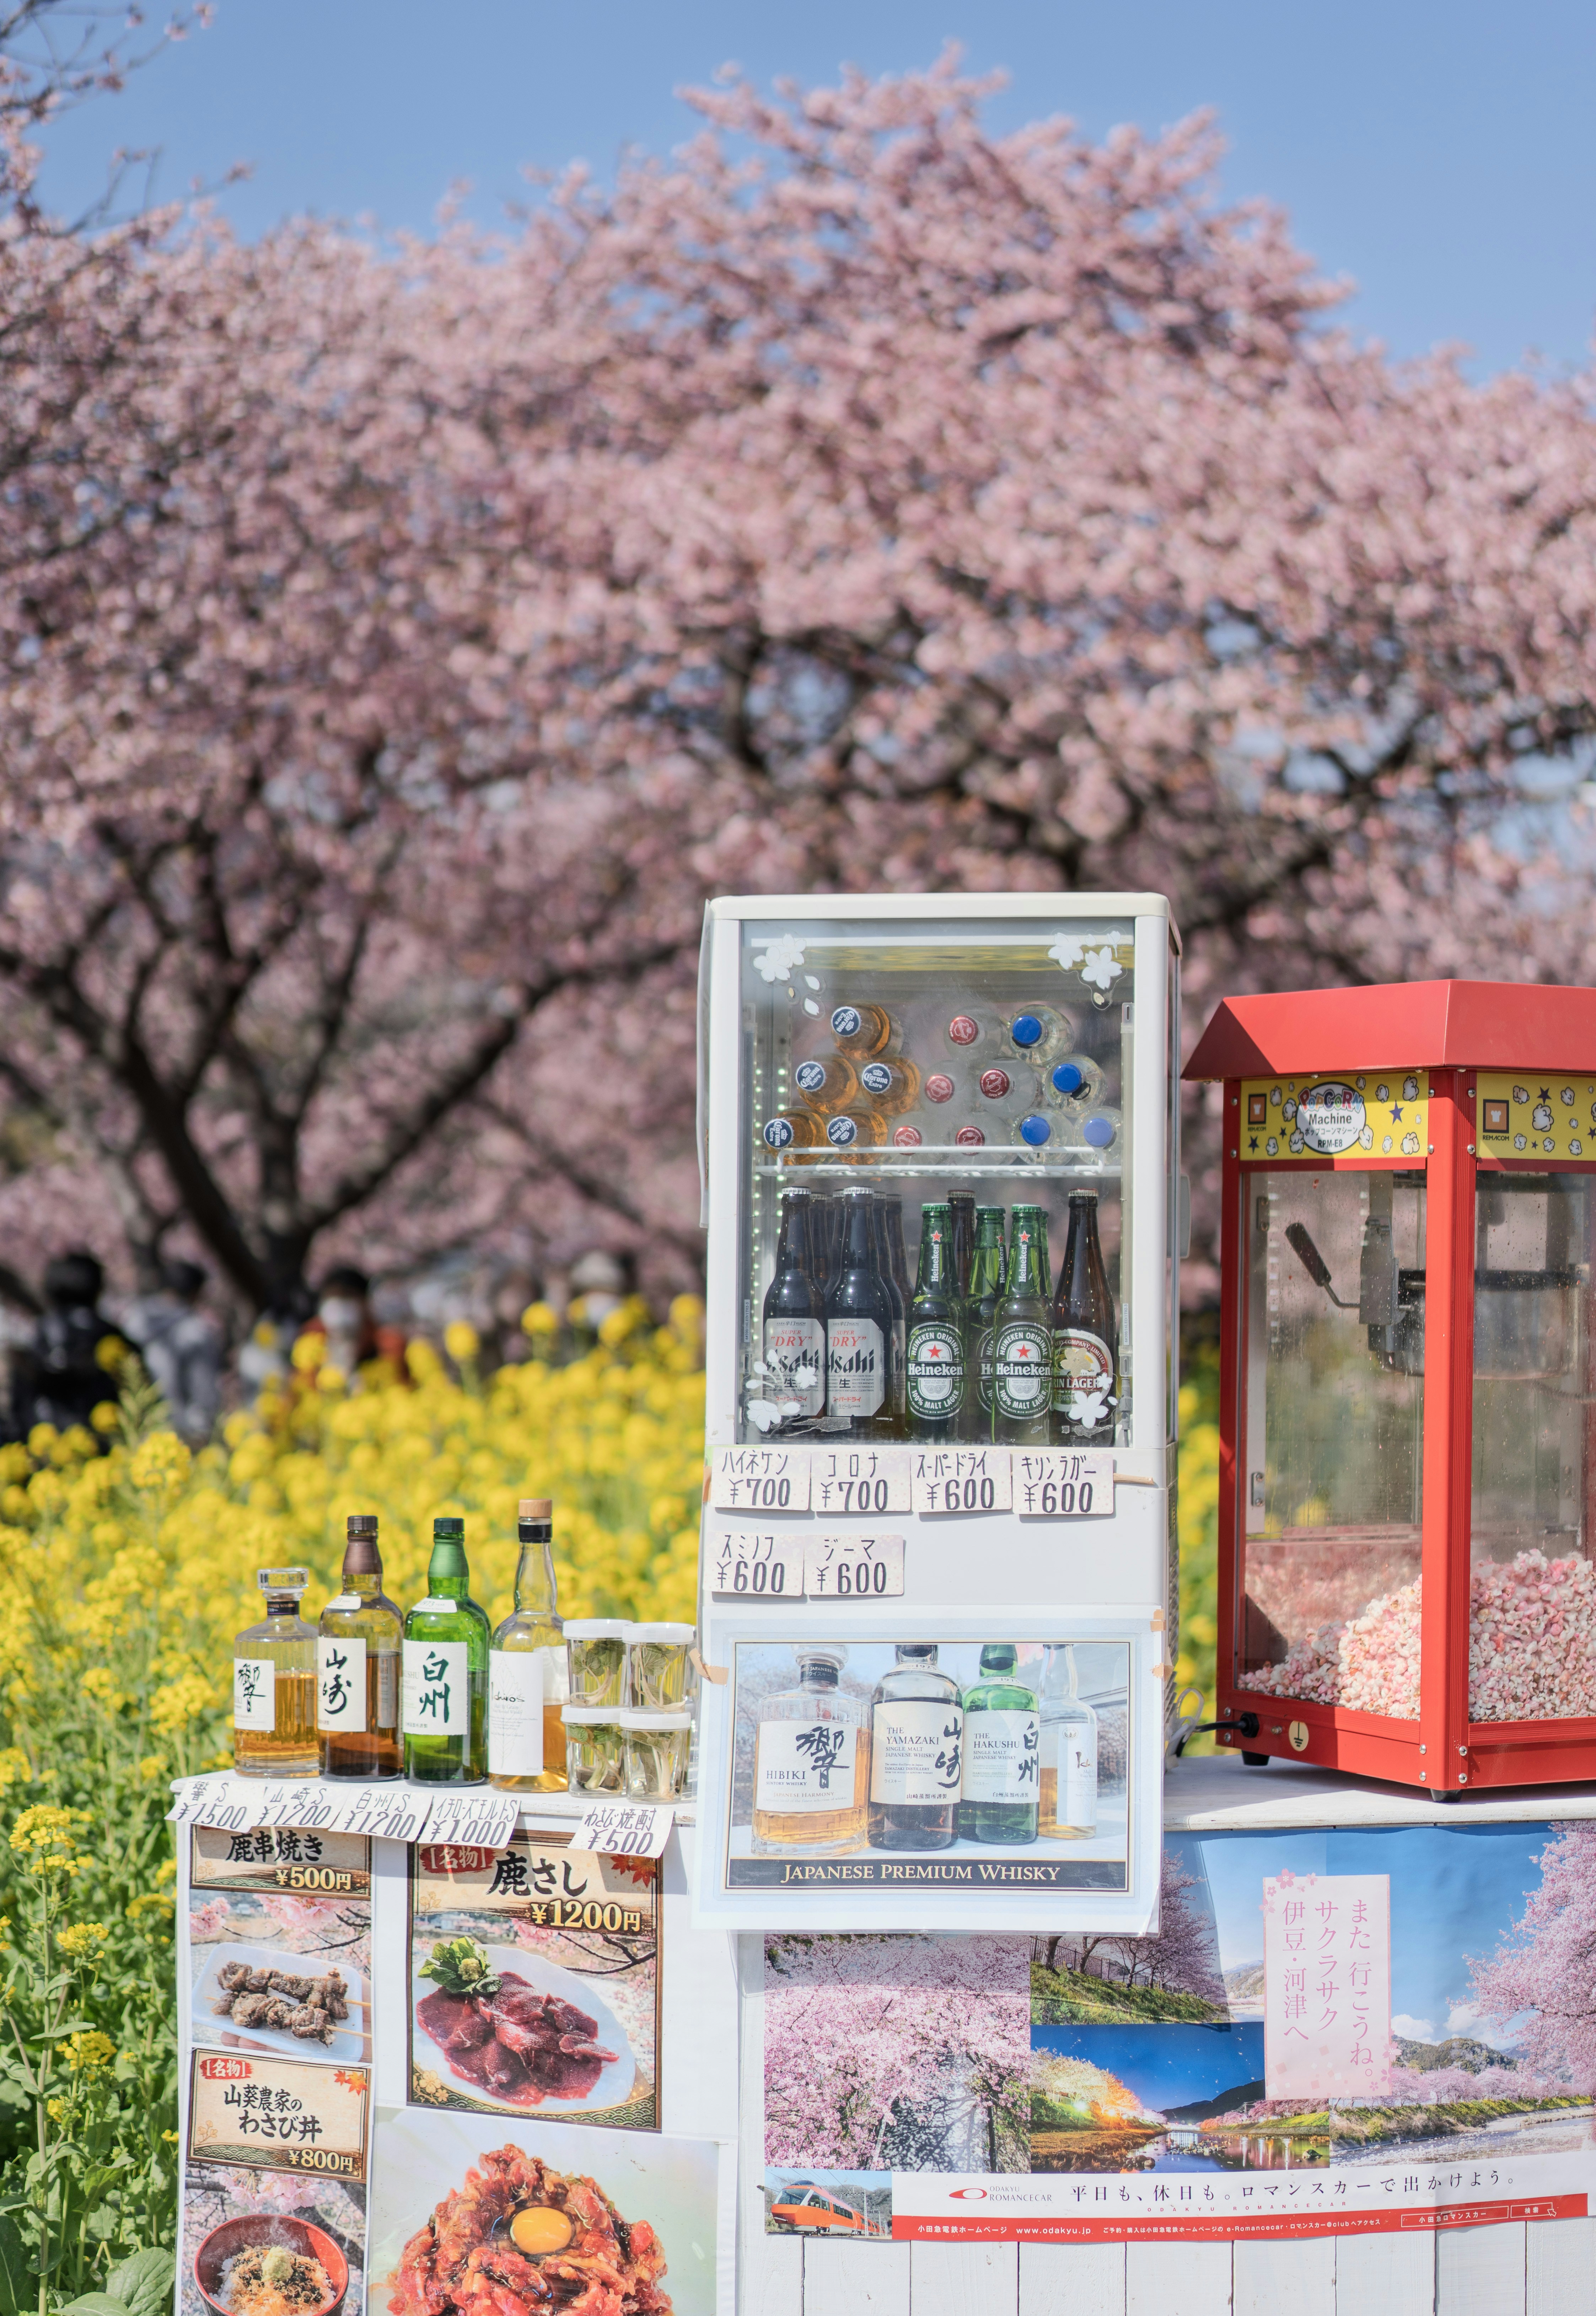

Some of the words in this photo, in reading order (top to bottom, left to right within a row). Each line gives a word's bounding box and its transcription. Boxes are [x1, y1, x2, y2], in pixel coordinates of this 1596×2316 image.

[835, 1012, 845, 1025] Extra
[837, 1010, 855, 1032] Corona
[801, 1067, 820, 1088] Corona
[810, 1074, 822, 1086] Extra
[864, 1073, 888, 1084] Corona
[985, 1076, 1003, 1091] Smirnoff
[831, 1122, 842, 1133] Extra
[831, 1120, 852, 1141] Corona
[1305, 1126, 1358, 1137] ポップコーンマシーン
[1309, 1113, 1352, 1126] Machine
[774, 1121, 783, 1146] Corona
[960, 1134, 979, 1145] Smirnoff
[1318, 1139, 1343, 1149] RPM-E8
[931, 1244, 940, 1282] Heineken
[912, 1332, 935, 1356] HEINEKEN
[937, 1332, 960, 1356] ORIGINAL
[1000, 1332, 1023, 1355] HEINEKEN
[1026, 1332, 1048, 1356] ORIGINAL
[1065, 1339, 1090, 1350] COMPANY,
[1091, 1346, 1105, 1364] LIMITED
[828, 1349, 874, 1374] Asahi
[908, 1363, 963, 1376] Heineken
[996, 1363, 1051, 1376] Heineken
[784, 1378, 797, 1387] 生
[839, 1379, 851, 1388] 生
[1054, 1379, 1065, 1388] RIN
[1067, 1378, 1099, 1388] LAGER
[912, 1390, 923, 1406] 100%
[924, 1401, 942, 1409] MALT
[944, 1390, 959, 1407] LAGER
[1000, 1389, 1011, 1406] 100%
[1012, 1401, 1030, 1409] MALT
[1032, 1390, 1047, 1407] LAGER
[721, 1451, 789, 1474] ハイネケン
[828, 1455, 879, 1477] コロナ
[917, 1451, 988, 1478] スーパードライ
[1021, 1455, 1096, 1481] キリンラガー
[730, 1478, 791, 1507] ¥700
[822, 1479, 888, 1512] ¥700
[925, 1477, 995, 1510] ¥600
[1024, 1482, 1093, 1513] ¥600
[722, 1534, 773, 1560] スミノフ
[824, 1538, 876, 1561] ジーマ
[716, 1561, 785, 1593] ¥600
[816, 1562, 887, 1594] ¥600
[323, 1648, 352, 1715] 山崎
[419, 1651, 451, 1723] 白州
[886, 1736, 939, 1745] YAMAZAKI
[796, 1726, 850, 1789] 響
[1018, 1720, 1039, 1787] 白州
[766, 1770, 806, 1780] HIBIKI
[177, 1802, 247, 1829] ¥1500
[257, 1804, 332, 1826] ¥1200
[344, 1810, 417, 1839] ¥1200
[584, 1806, 657, 1831] わさび焼酎
[225, 1830, 323, 1863] 鹿串焼き
[587, 1829, 654, 1855] ¥500
[275, 1866, 352, 1890] ¥500円
[485, 1850, 588, 1897] 鹿さし
[781, 1864, 874, 1883] JAPANESE
[880, 1864, 972, 1880] PREMIUM
[978, 1864, 1060, 1881] WHISKY
[531, 1899, 641, 1932] ¥1200円
[1282, 1900, 1309, 2040] 伊豆・河津へ
[1315, 1901, 1339, 2032] サクラサク
[224, 2084, 302, 2112] 山葵農家の
[239, 2109, 323, 2143] わさび丼
[288, 2149, 354, 2172] ¥800円
[1070, 2170, 1513, 2202] 平日も、休日も。ロマンスカーで出かけよう。
[1233, 2202, 1346, 2211] ROMANCECAR
[1419, 2211, 1487, 2224] 小田急ロマンスカー
[918, 2225, 1007, 2234] 小田急電鉄ホームページ
